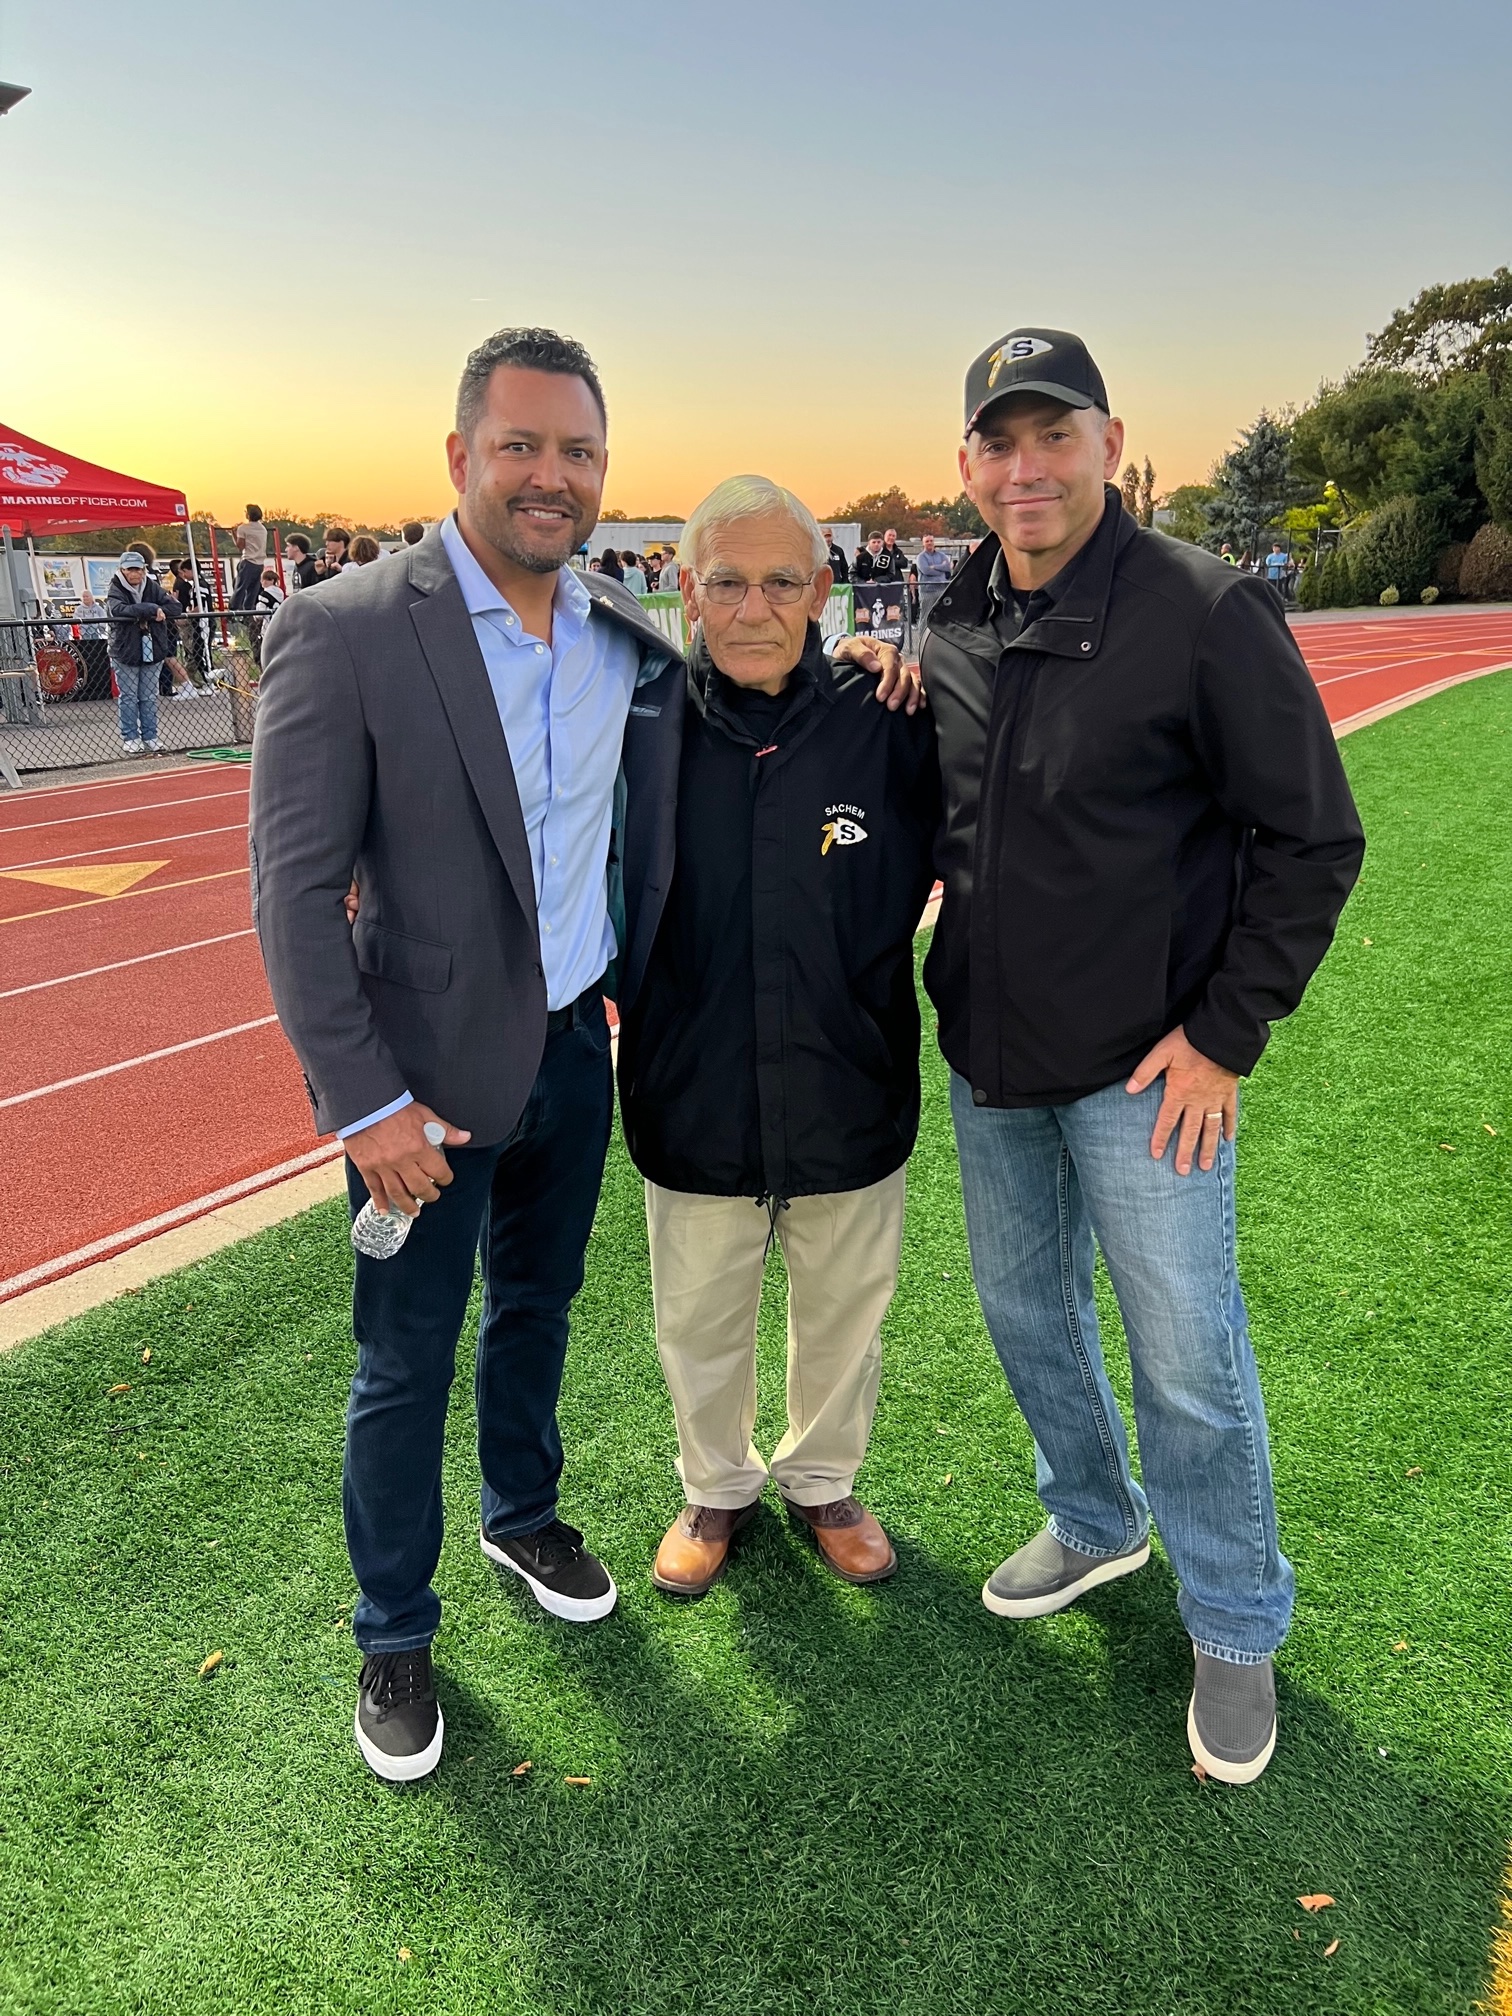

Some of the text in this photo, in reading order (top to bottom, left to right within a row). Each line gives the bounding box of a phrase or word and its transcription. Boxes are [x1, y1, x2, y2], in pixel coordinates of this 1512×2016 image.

[1011, 339, 1034, 359] S
[1, 495, 148, 508] MARINEOFFICER.COM
[877, 555, 890, 569] S
[824, 803, 865, 819] SACHEM
[840, 824, 856, 840] S
